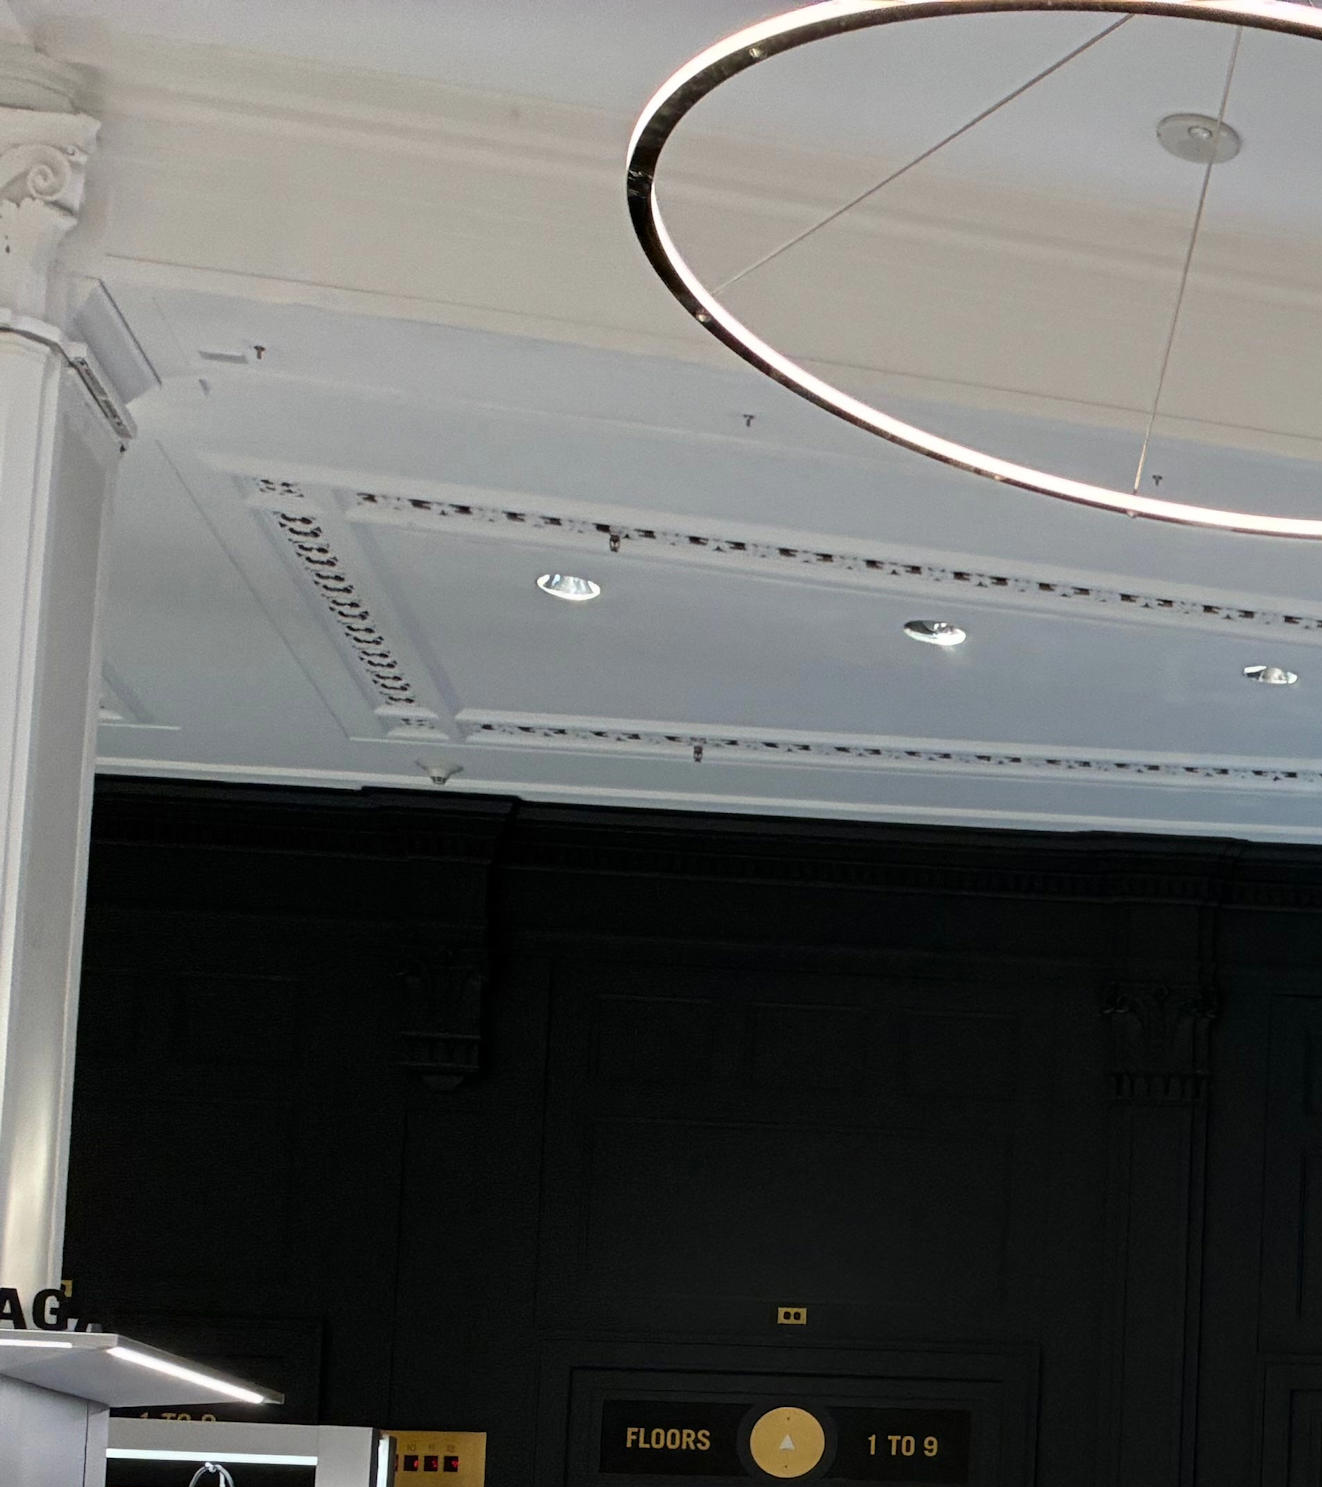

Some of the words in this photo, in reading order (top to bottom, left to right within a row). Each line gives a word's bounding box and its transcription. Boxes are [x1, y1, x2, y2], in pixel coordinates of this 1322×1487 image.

[0, 1287, 104, 1332] AG
[626, 1427, 711, 1450] FLOORS
[868, 1434, 876, 1455] 1
[887, 1435, 915, 1457] TO
[923, 1436, 938, 1457] 9
